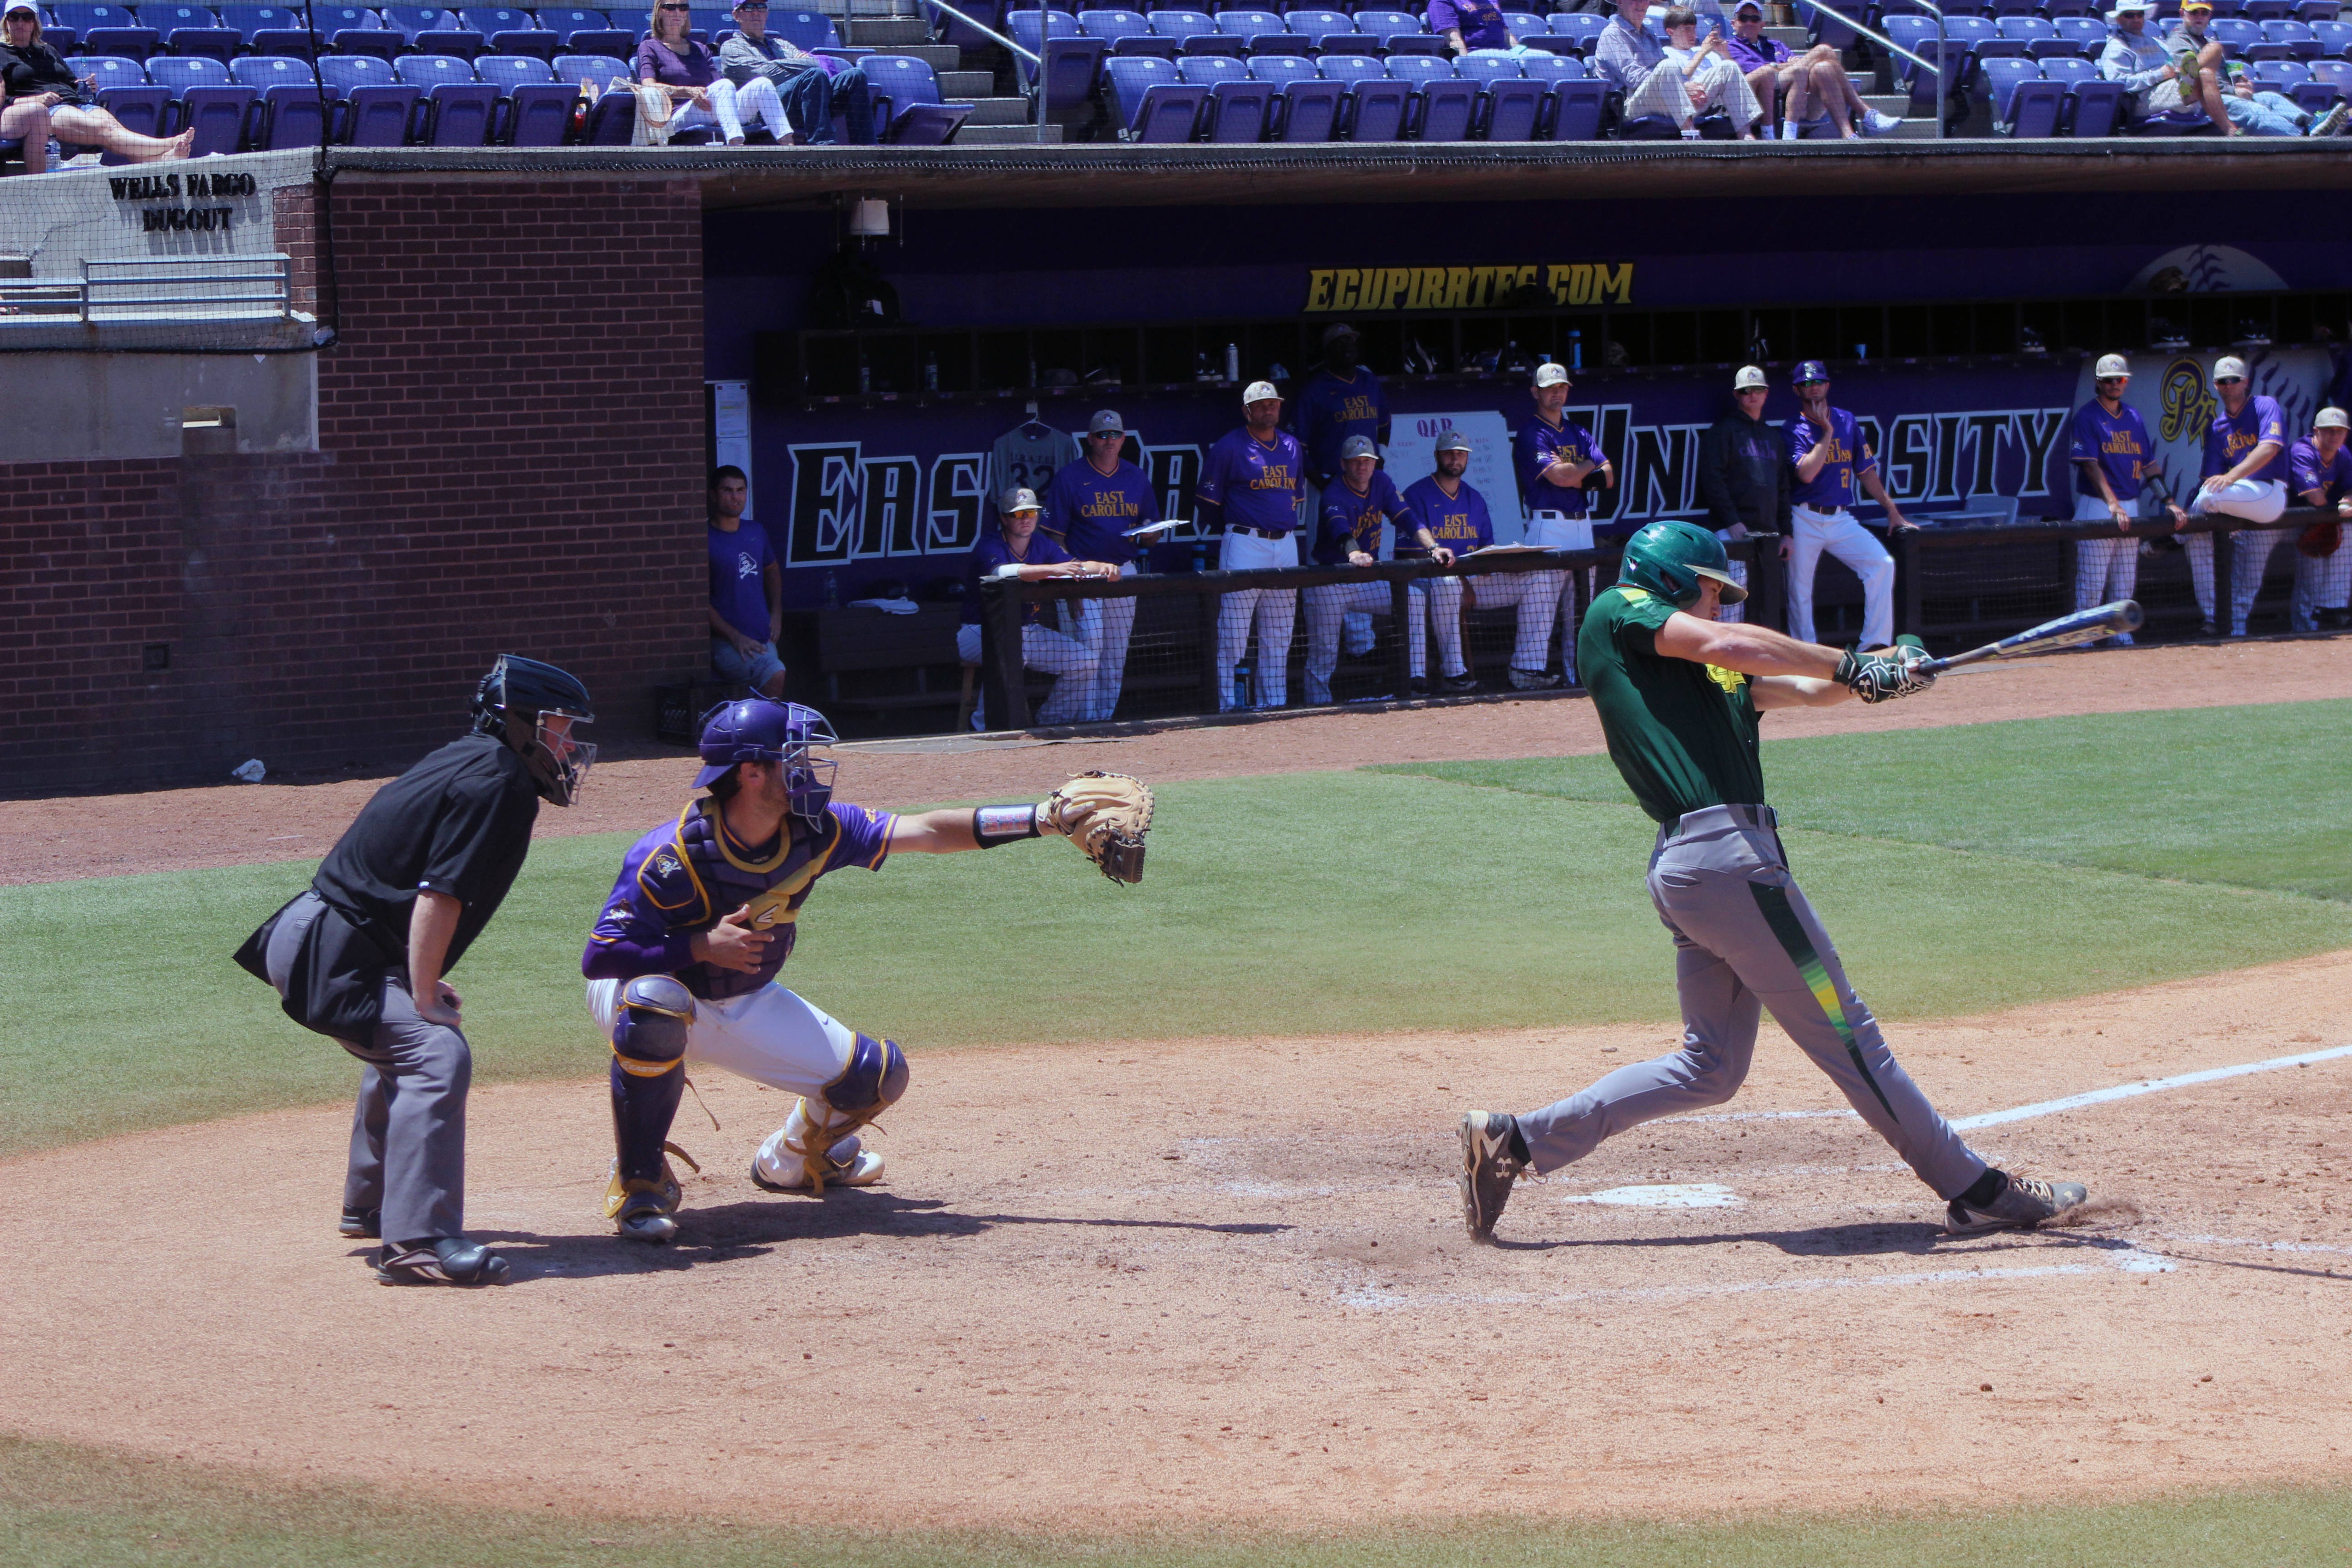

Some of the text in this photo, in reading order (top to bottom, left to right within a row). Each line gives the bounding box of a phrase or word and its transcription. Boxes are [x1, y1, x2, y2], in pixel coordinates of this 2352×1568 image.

[109, 173, 255, 200] WELLS FARGO
[143, 207, 233, 232] DUGOUT
[1303, 263, 1634, 312] ECUPIRATESCOM
[1343, 395, 1369, 408] EAST
[1334, 406, 1378, 422] CAROLIN
[2102, 442, 2141, 455] CAROLINA
[1262, 465, 1288, 478] EAST
[1010, 462, 1054, 499] 32
[1250, 478, 1297, 490] CAROLIN
[786, 441, 992, 568] EAS
[1094, 491, 1124, 504] EAST
[1081, 503, 1138, 517] CAROLINA
[1444, 513, 1467, 527] EAST
[1432, 526, 1479, 539] CAROLINA
[628, 1064, 667, 1073] EASTON
